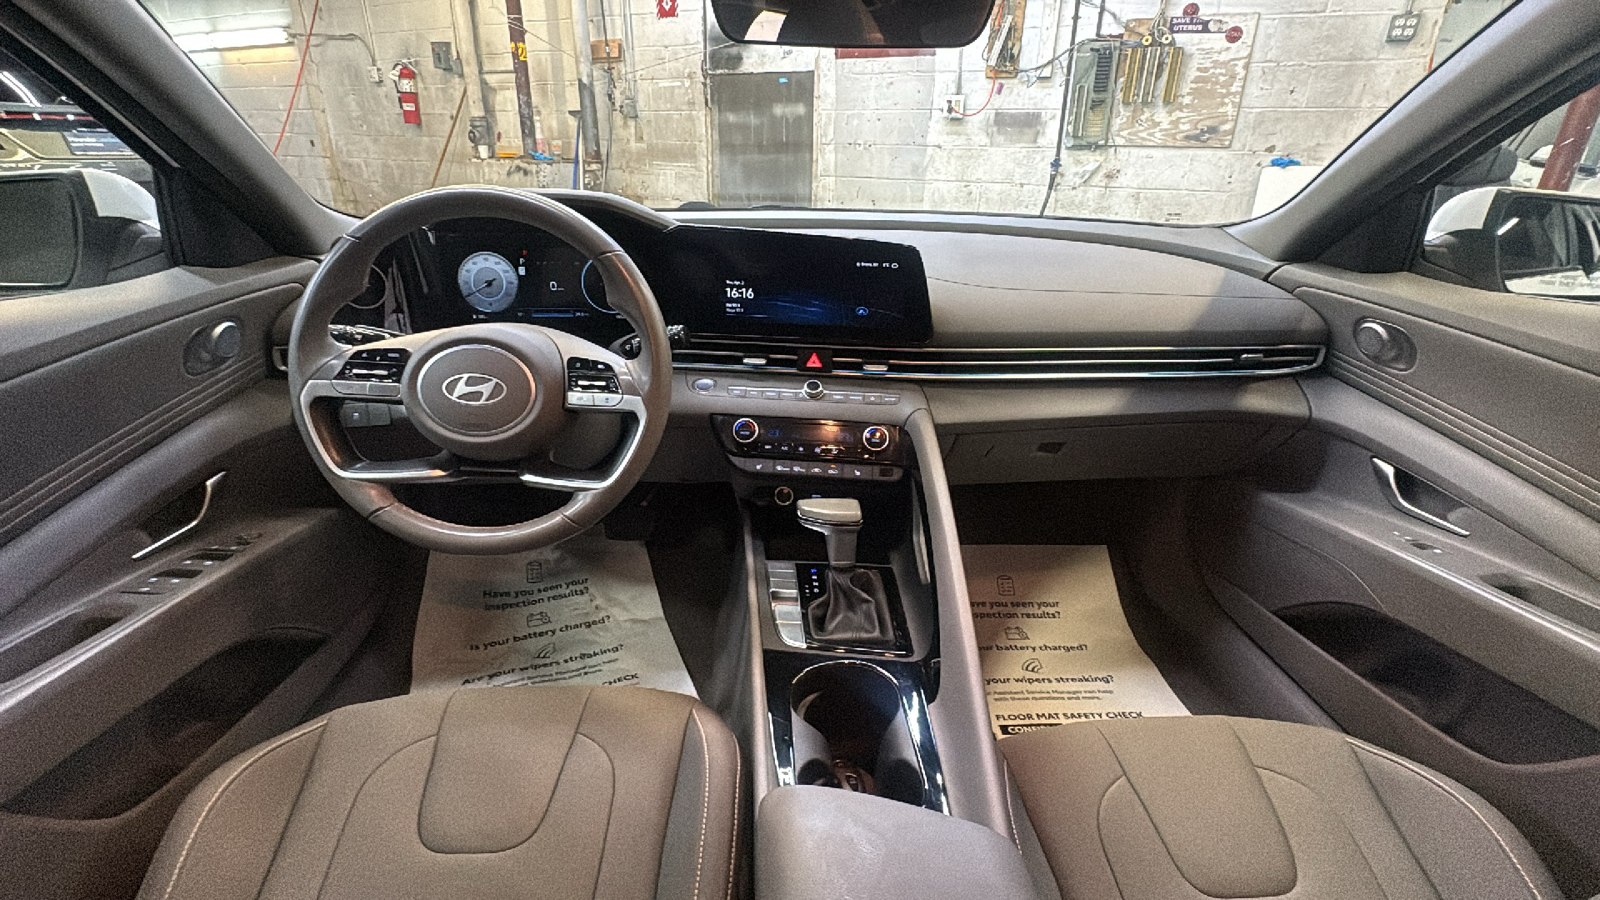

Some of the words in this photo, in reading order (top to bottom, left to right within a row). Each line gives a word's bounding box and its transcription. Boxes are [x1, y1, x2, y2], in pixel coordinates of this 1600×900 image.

[725, 287, 754, 299] 16:16
[483, 590, 511, 599] Have
[514, 590, 534, 598] you
[538, 583, 562, 593] seen
[565, 578, 589, 589] your
[484, 598, 544, 612] inspection
[547, 586, 589, 602] results?
[988, 601, 1008, 609] you
[1035, 601, 1060, 610] your
[972, 610, 1019, 619] spection
[1021, 610, 1061, 619] results?
[483, 637, 510, 650] your
[513, 628, 557, 643] battery
[559, 615, 611, 633] charged?
[995, 644, 1036, 653] battery
[1039, 643, 1088, 653] charged?
[461, 676, 484, 686] Are
[487, 667, 516, 680] your
[519, 660, 560, 671] wipers
[563, 644, 624, 664] streaking?
[985, 677, 1010, 686] your
[1013, 676, 1053, 685] wipers
[1055, 675, 1114, 684] streaking?
[995, 713, 1034, 721] FLOOR
[1105, 711, 1143, 719] CHECK
